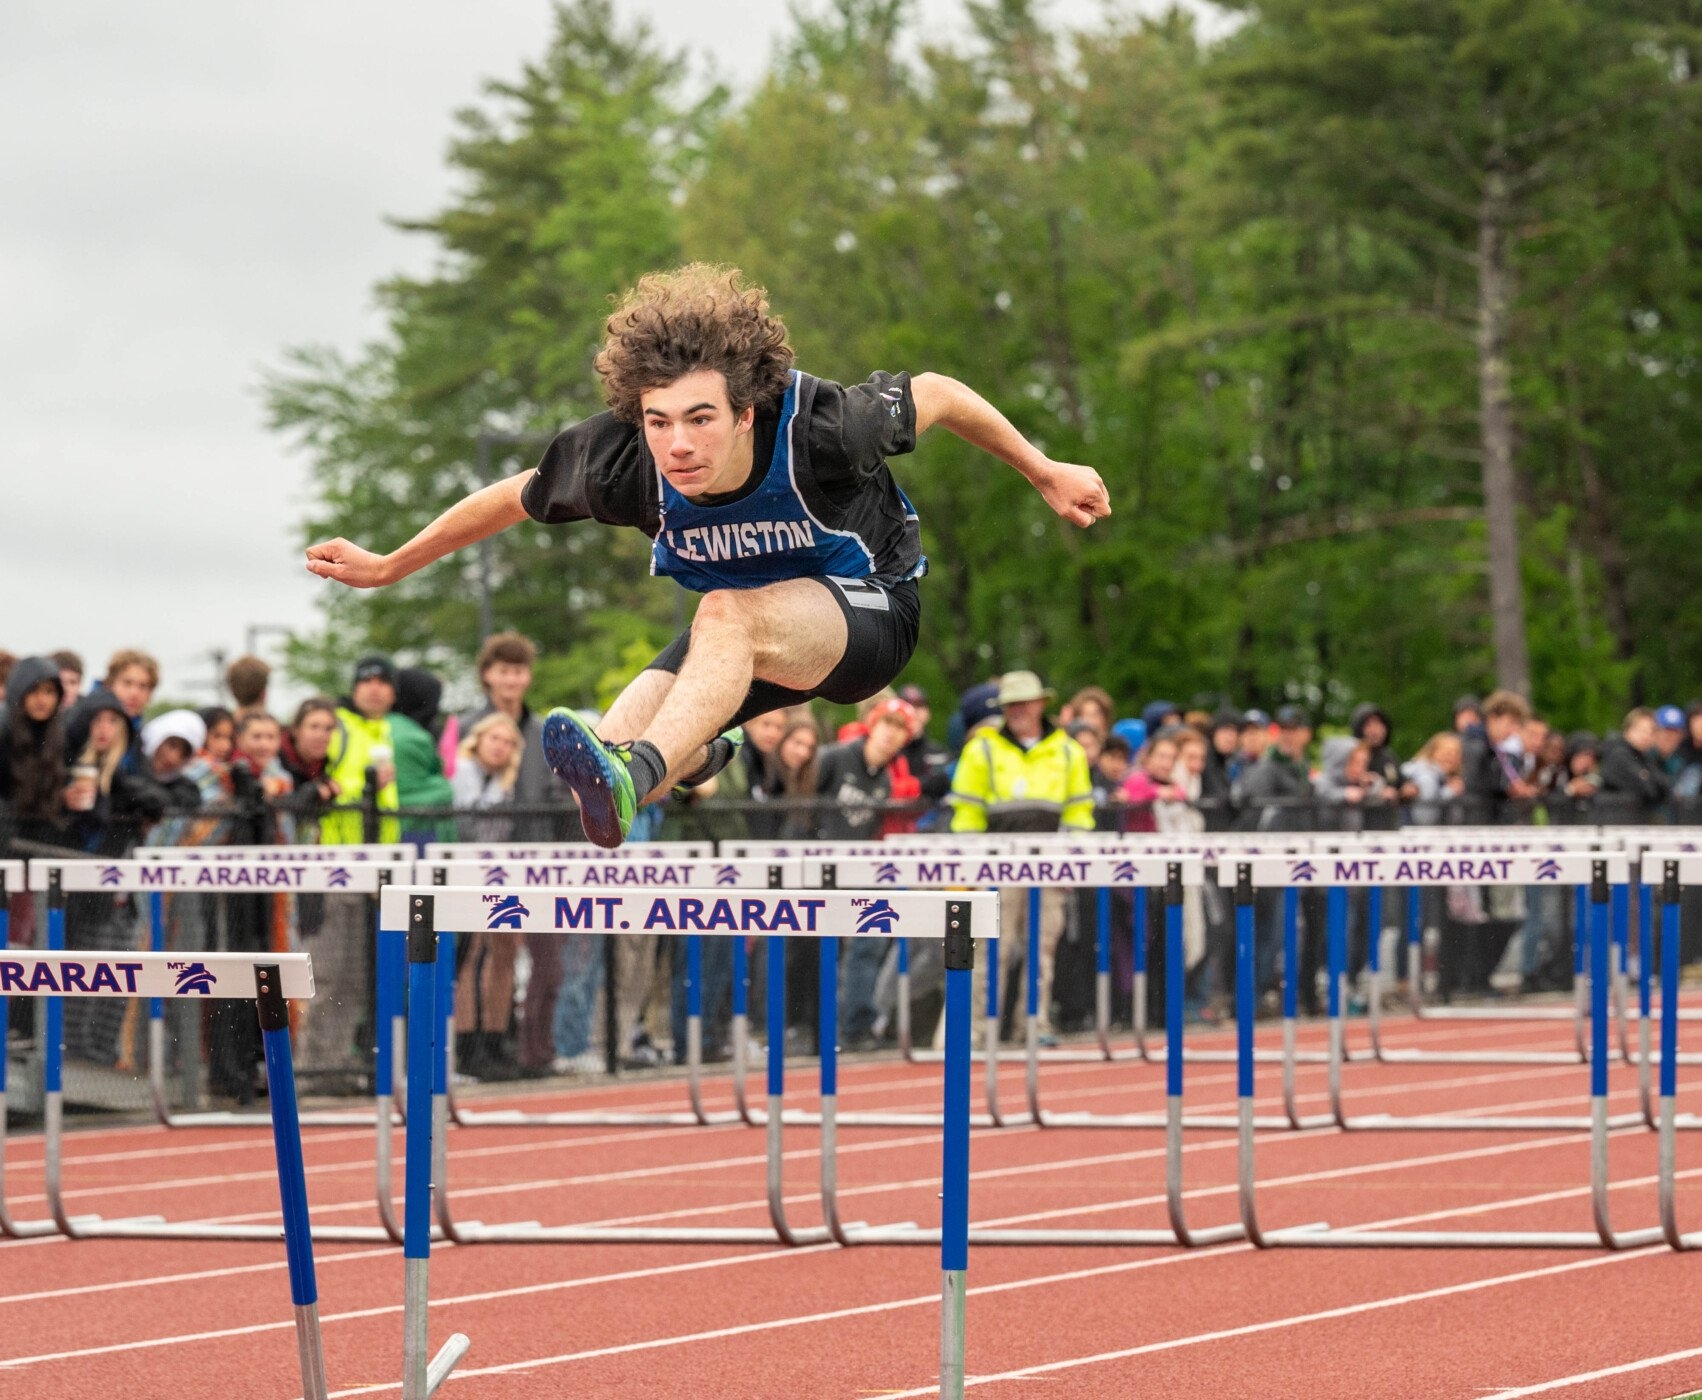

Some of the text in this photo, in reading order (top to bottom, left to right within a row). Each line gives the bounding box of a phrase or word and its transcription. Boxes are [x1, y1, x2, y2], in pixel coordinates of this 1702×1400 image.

[666, 520, 816, 562] LEWISTON
[141, 867, 307, 887] MT. ARARAT
[525, 865, 695, 886] MT. ARARAT
[917, 862, 1093, 883] MT. ARARAT
[1334, 860, 1515, 882] MT. ARARAT
[554, 897, 826, 932] MT. ARARAT
[0, 961, 144, 993] RARAT
